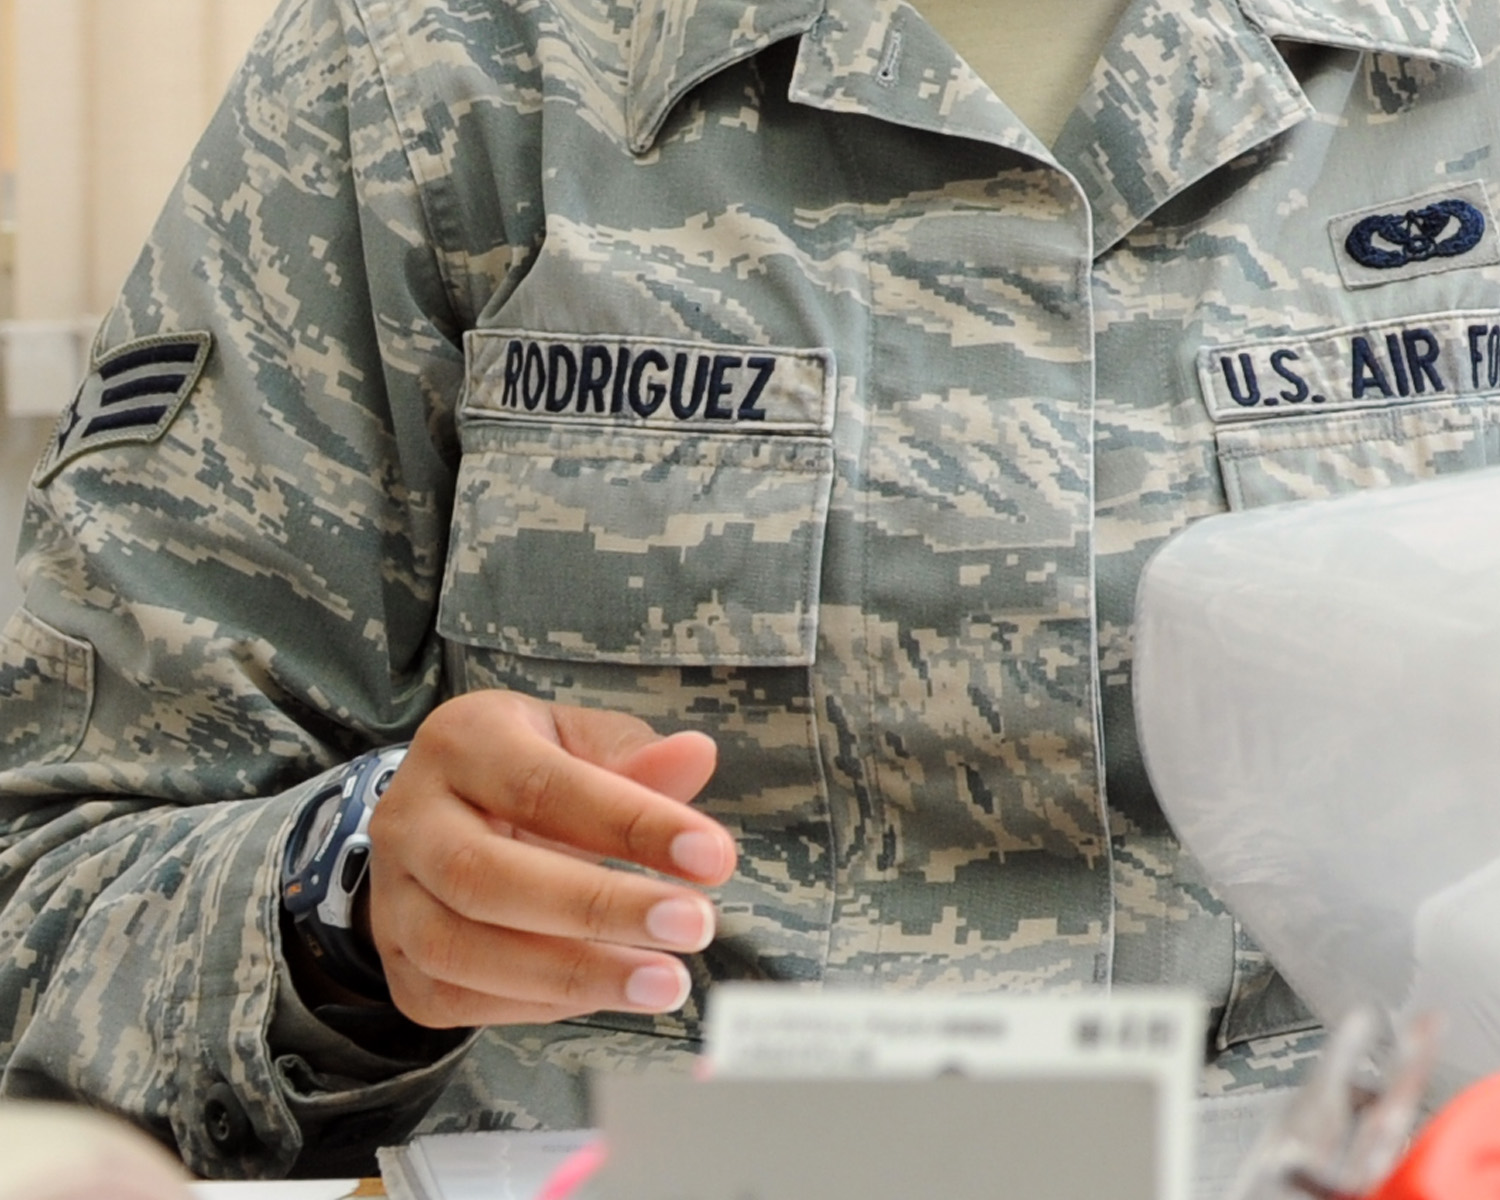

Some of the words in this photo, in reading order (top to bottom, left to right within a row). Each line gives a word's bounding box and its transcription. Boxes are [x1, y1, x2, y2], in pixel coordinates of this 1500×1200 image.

[502, 340, 776, 420] RODRIGUEZ
[1221, 349, 1326, 406] U.S.
[1351, 329, 1445, 399] AIR
